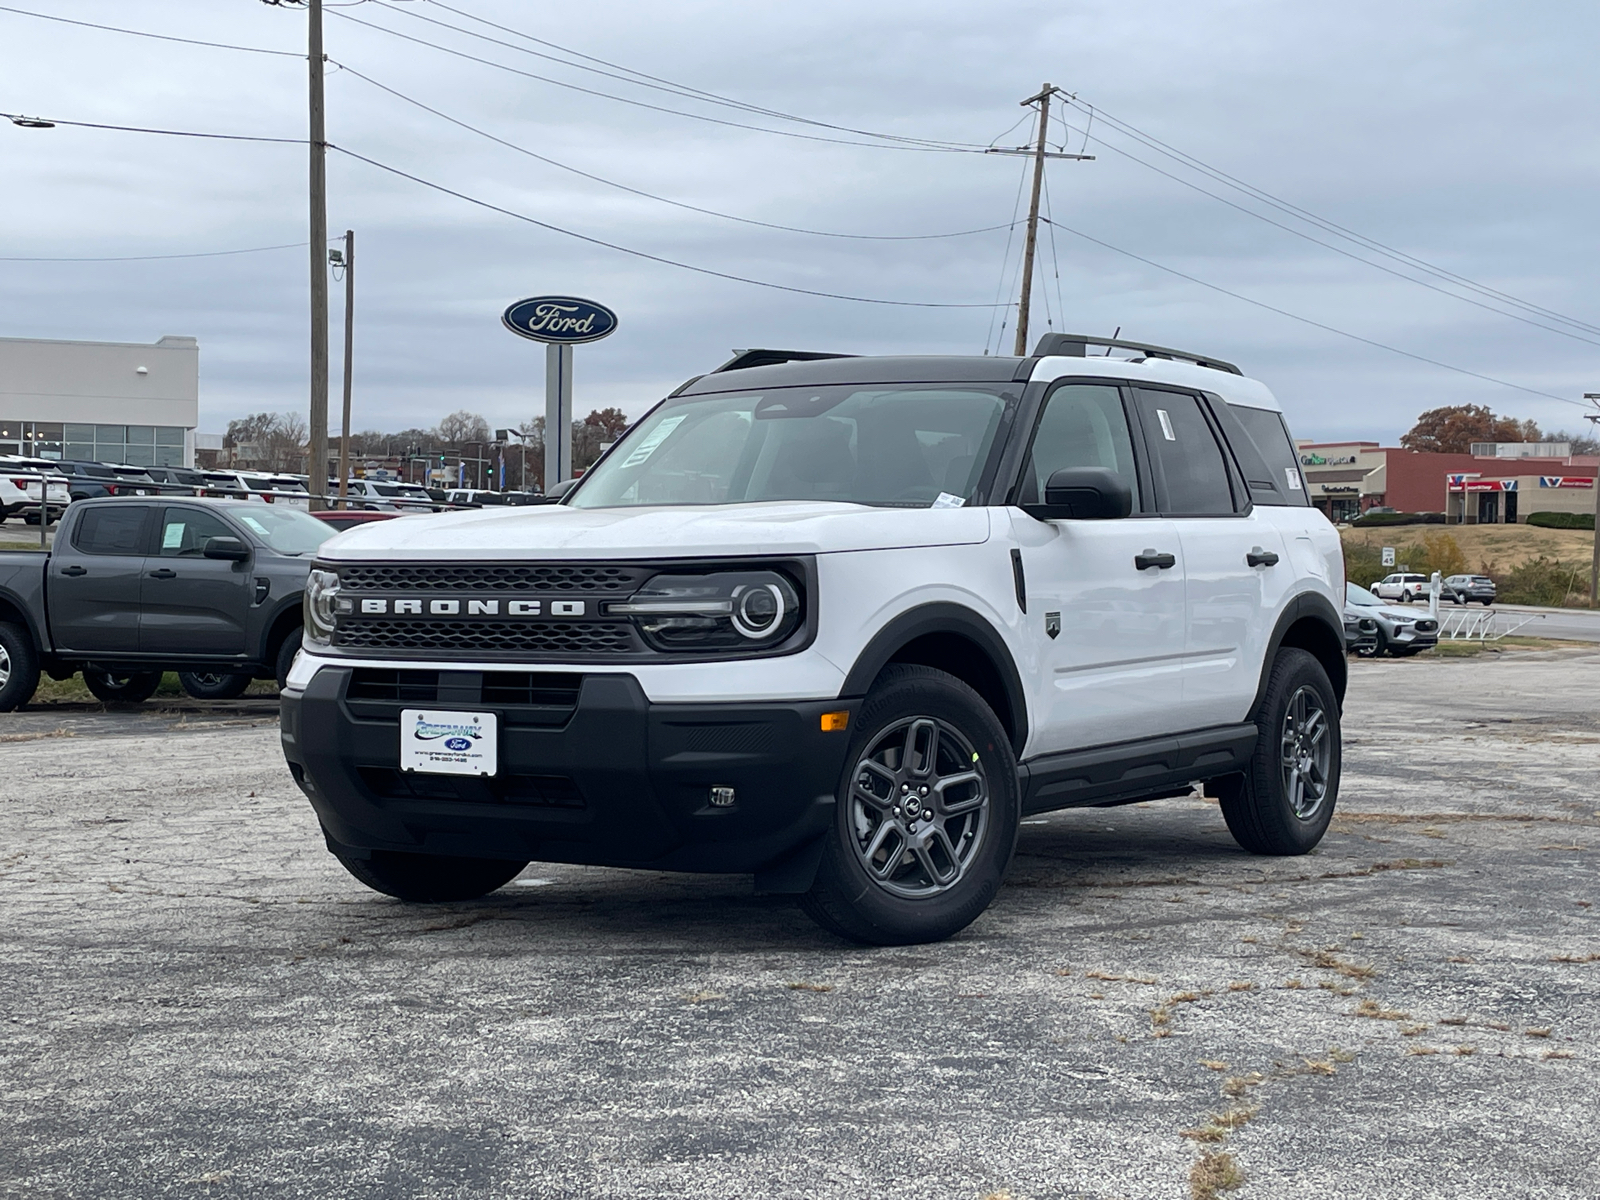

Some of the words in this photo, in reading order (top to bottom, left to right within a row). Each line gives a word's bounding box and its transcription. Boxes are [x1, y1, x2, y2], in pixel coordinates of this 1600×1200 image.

[528, 303, 596, 333] Ford
[361, 599, 585, 616] BRONCO
[450, 739, 467, 749] Ford
